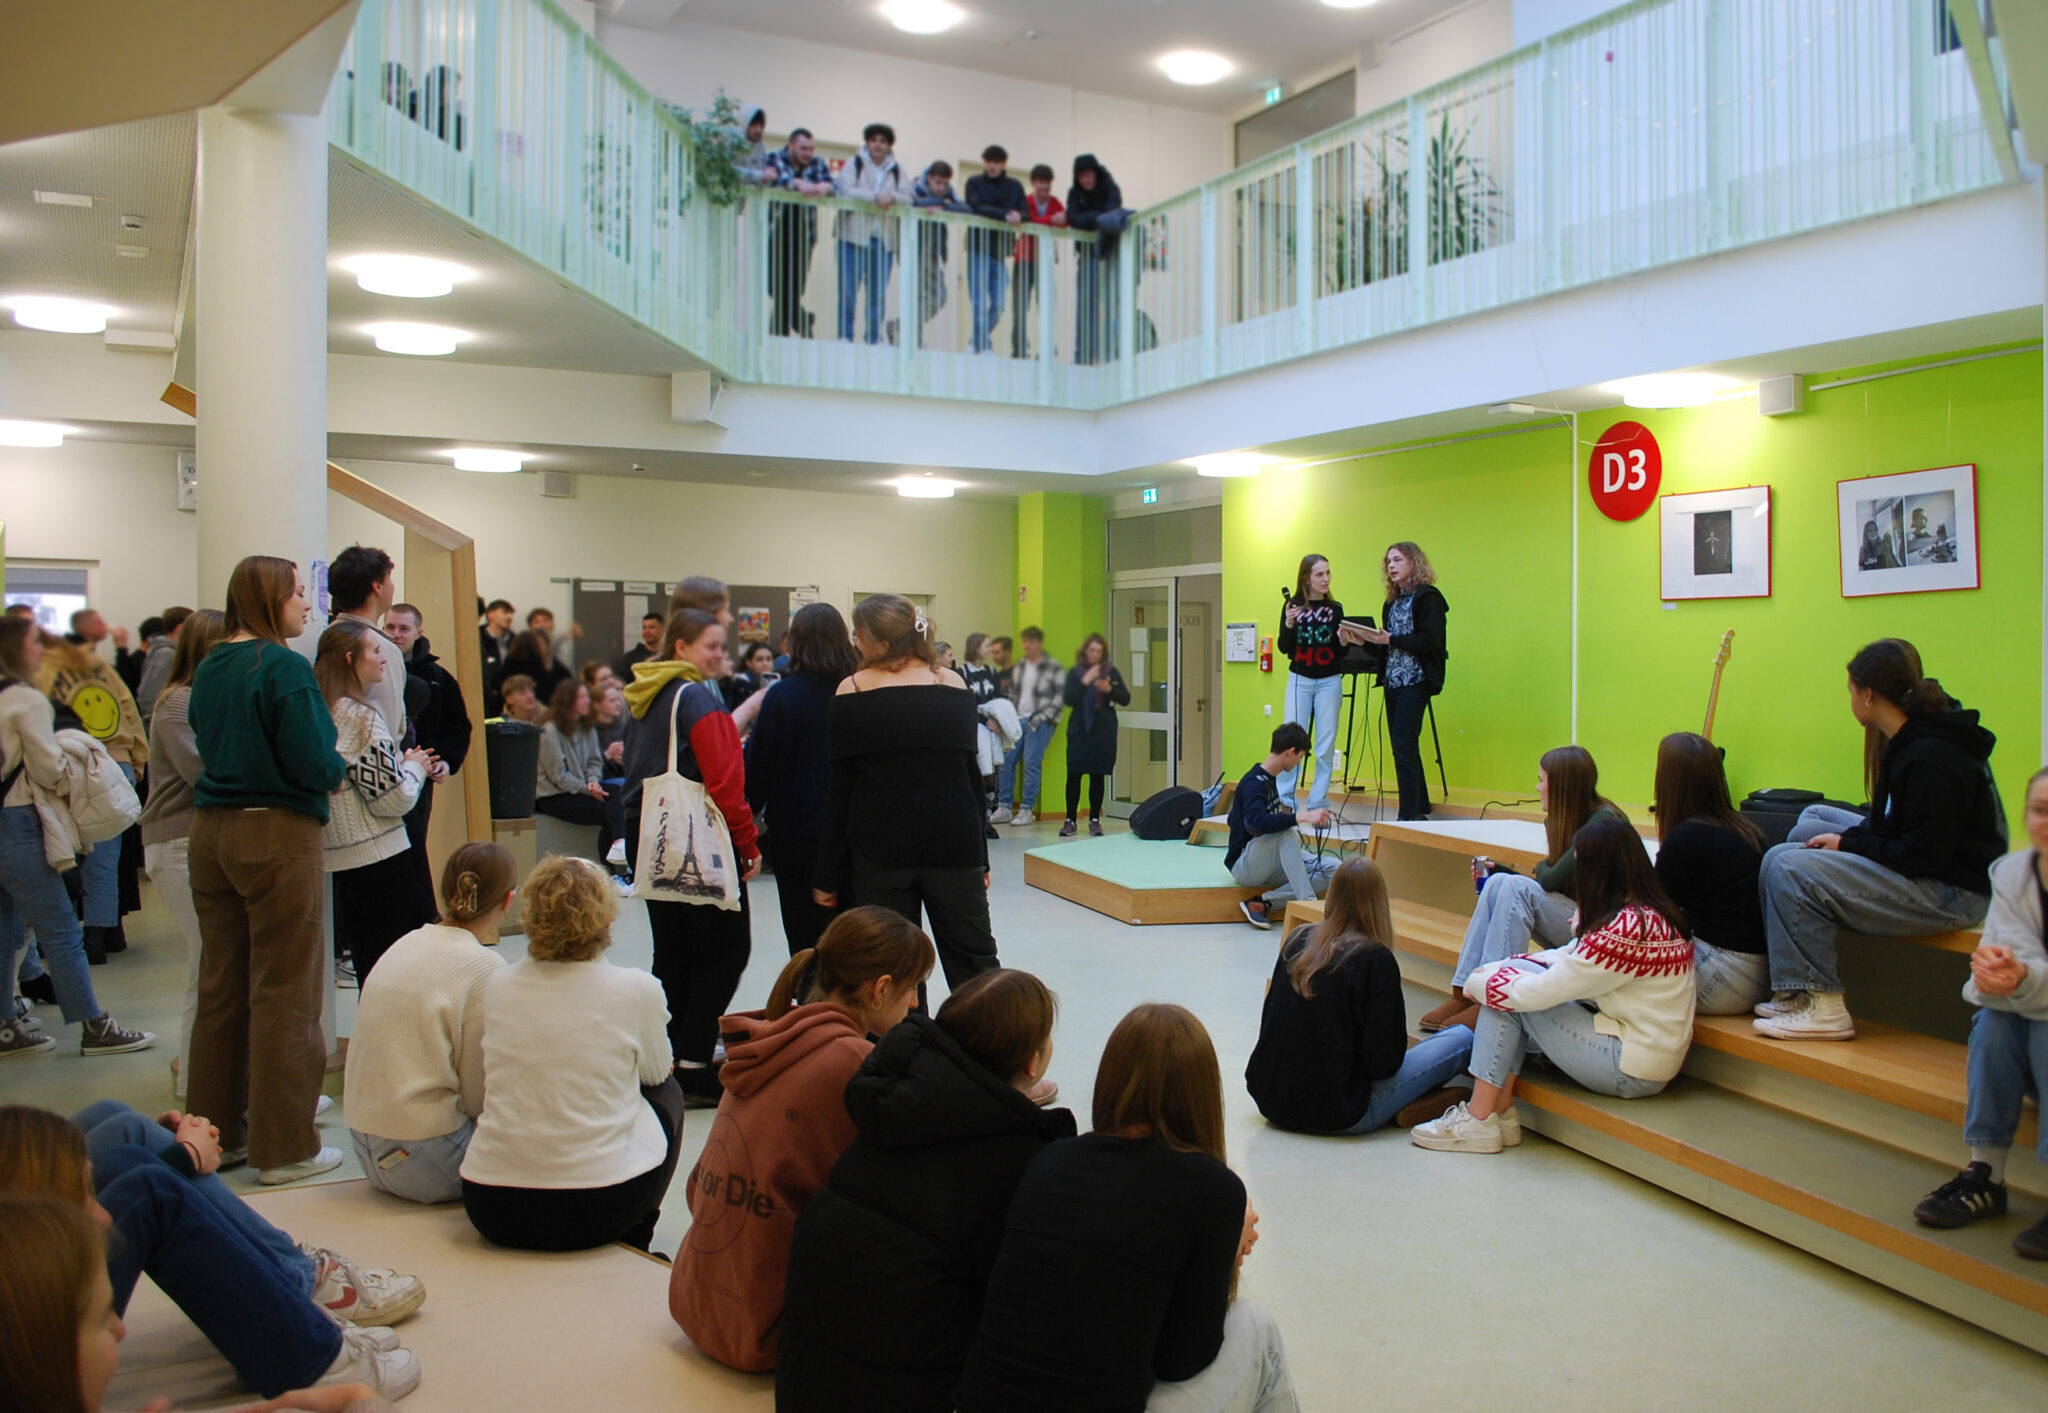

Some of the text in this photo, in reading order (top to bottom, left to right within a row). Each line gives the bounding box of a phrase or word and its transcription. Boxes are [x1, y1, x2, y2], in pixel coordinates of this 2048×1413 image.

[1603, 448, 1647, 494] D3
[1179, 615, 1200, 626] 309
[1296, 606, 1334, 624] HO
[1296, 625, 1333, 646] HO
[1295, 646, 1336, 668] HO
[653, 811, 669, 876] PARIS
[702, 1170, 724, 1199] or
[724, 1172, 774, 1220] Die
